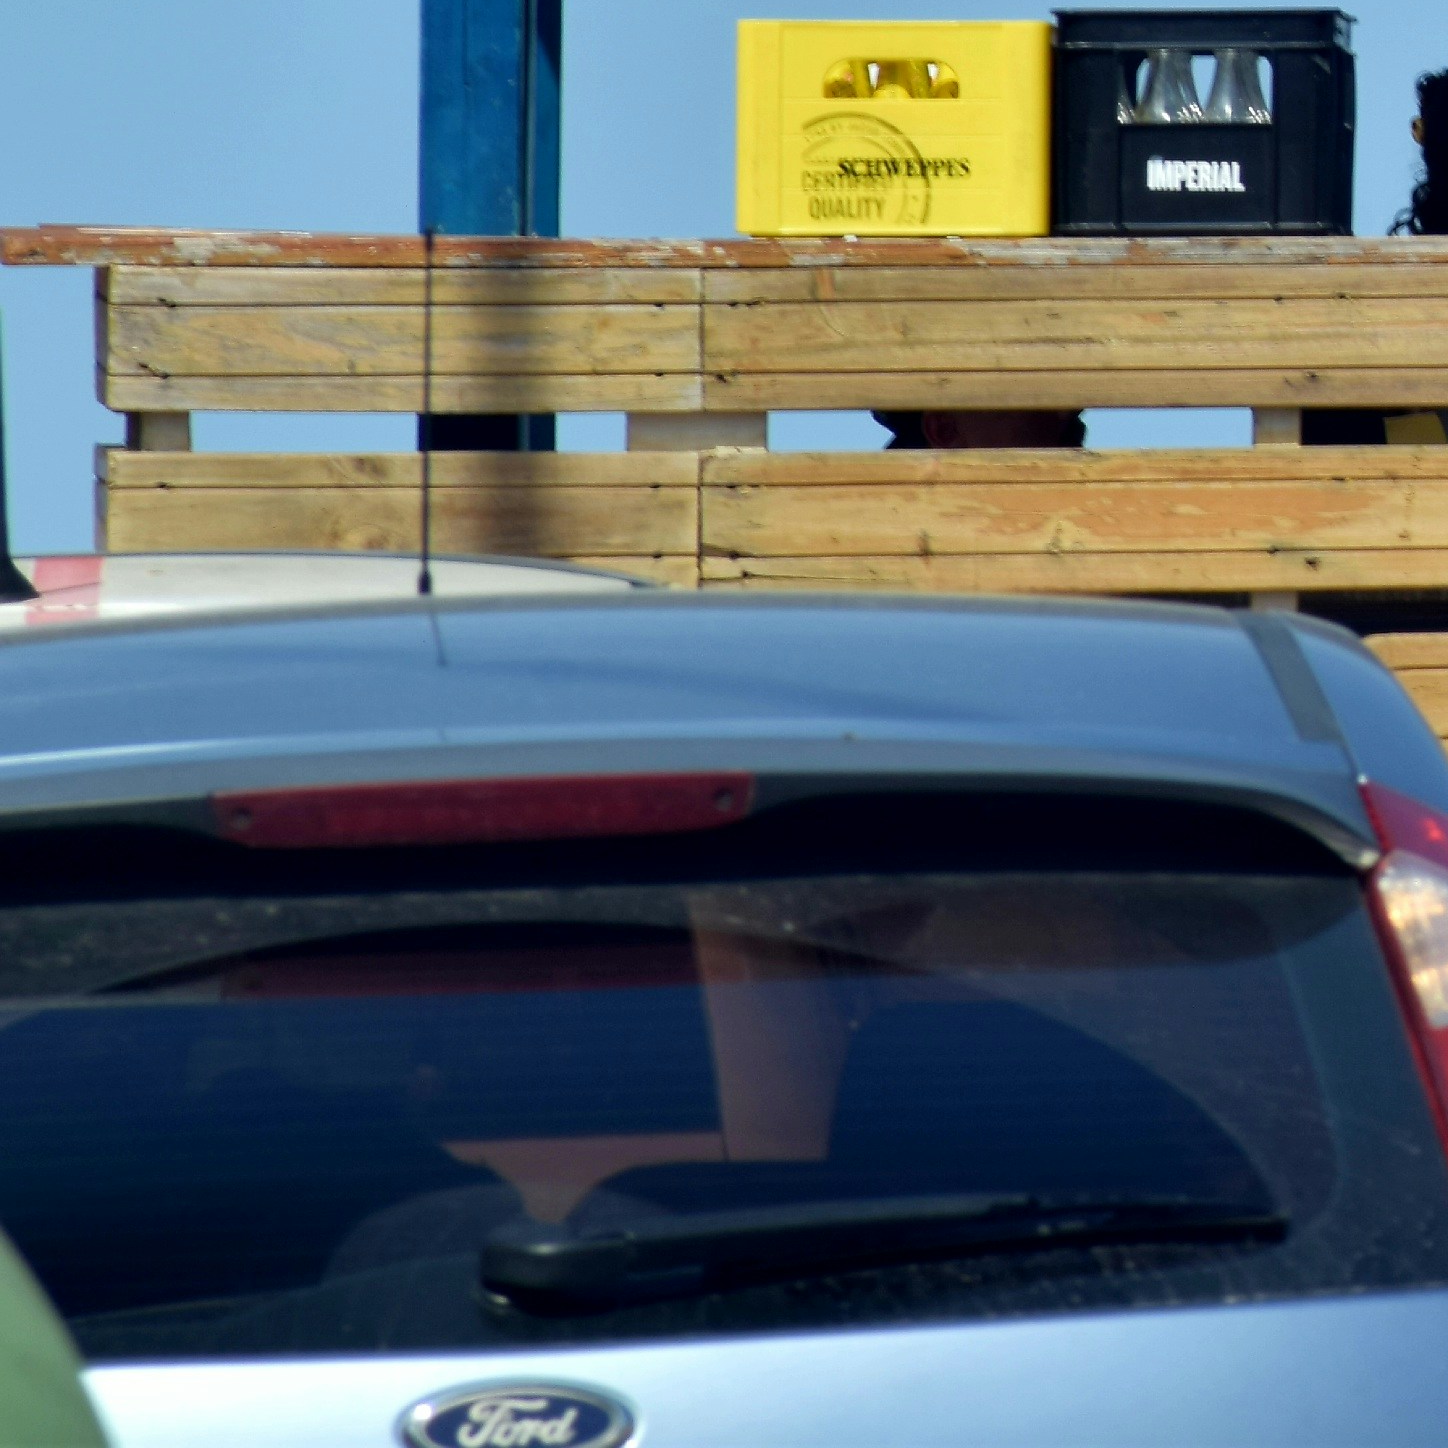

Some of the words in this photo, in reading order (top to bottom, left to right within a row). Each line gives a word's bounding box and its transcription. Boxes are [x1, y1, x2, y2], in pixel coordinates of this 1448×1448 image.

[837, 157, 972, 178] SCHWEPPES
[1146, 158, 1246, 192] IMPERIAL
[807, 195, 886, 221] QUALITY
[456, 1398, 579, 1447] Ford
